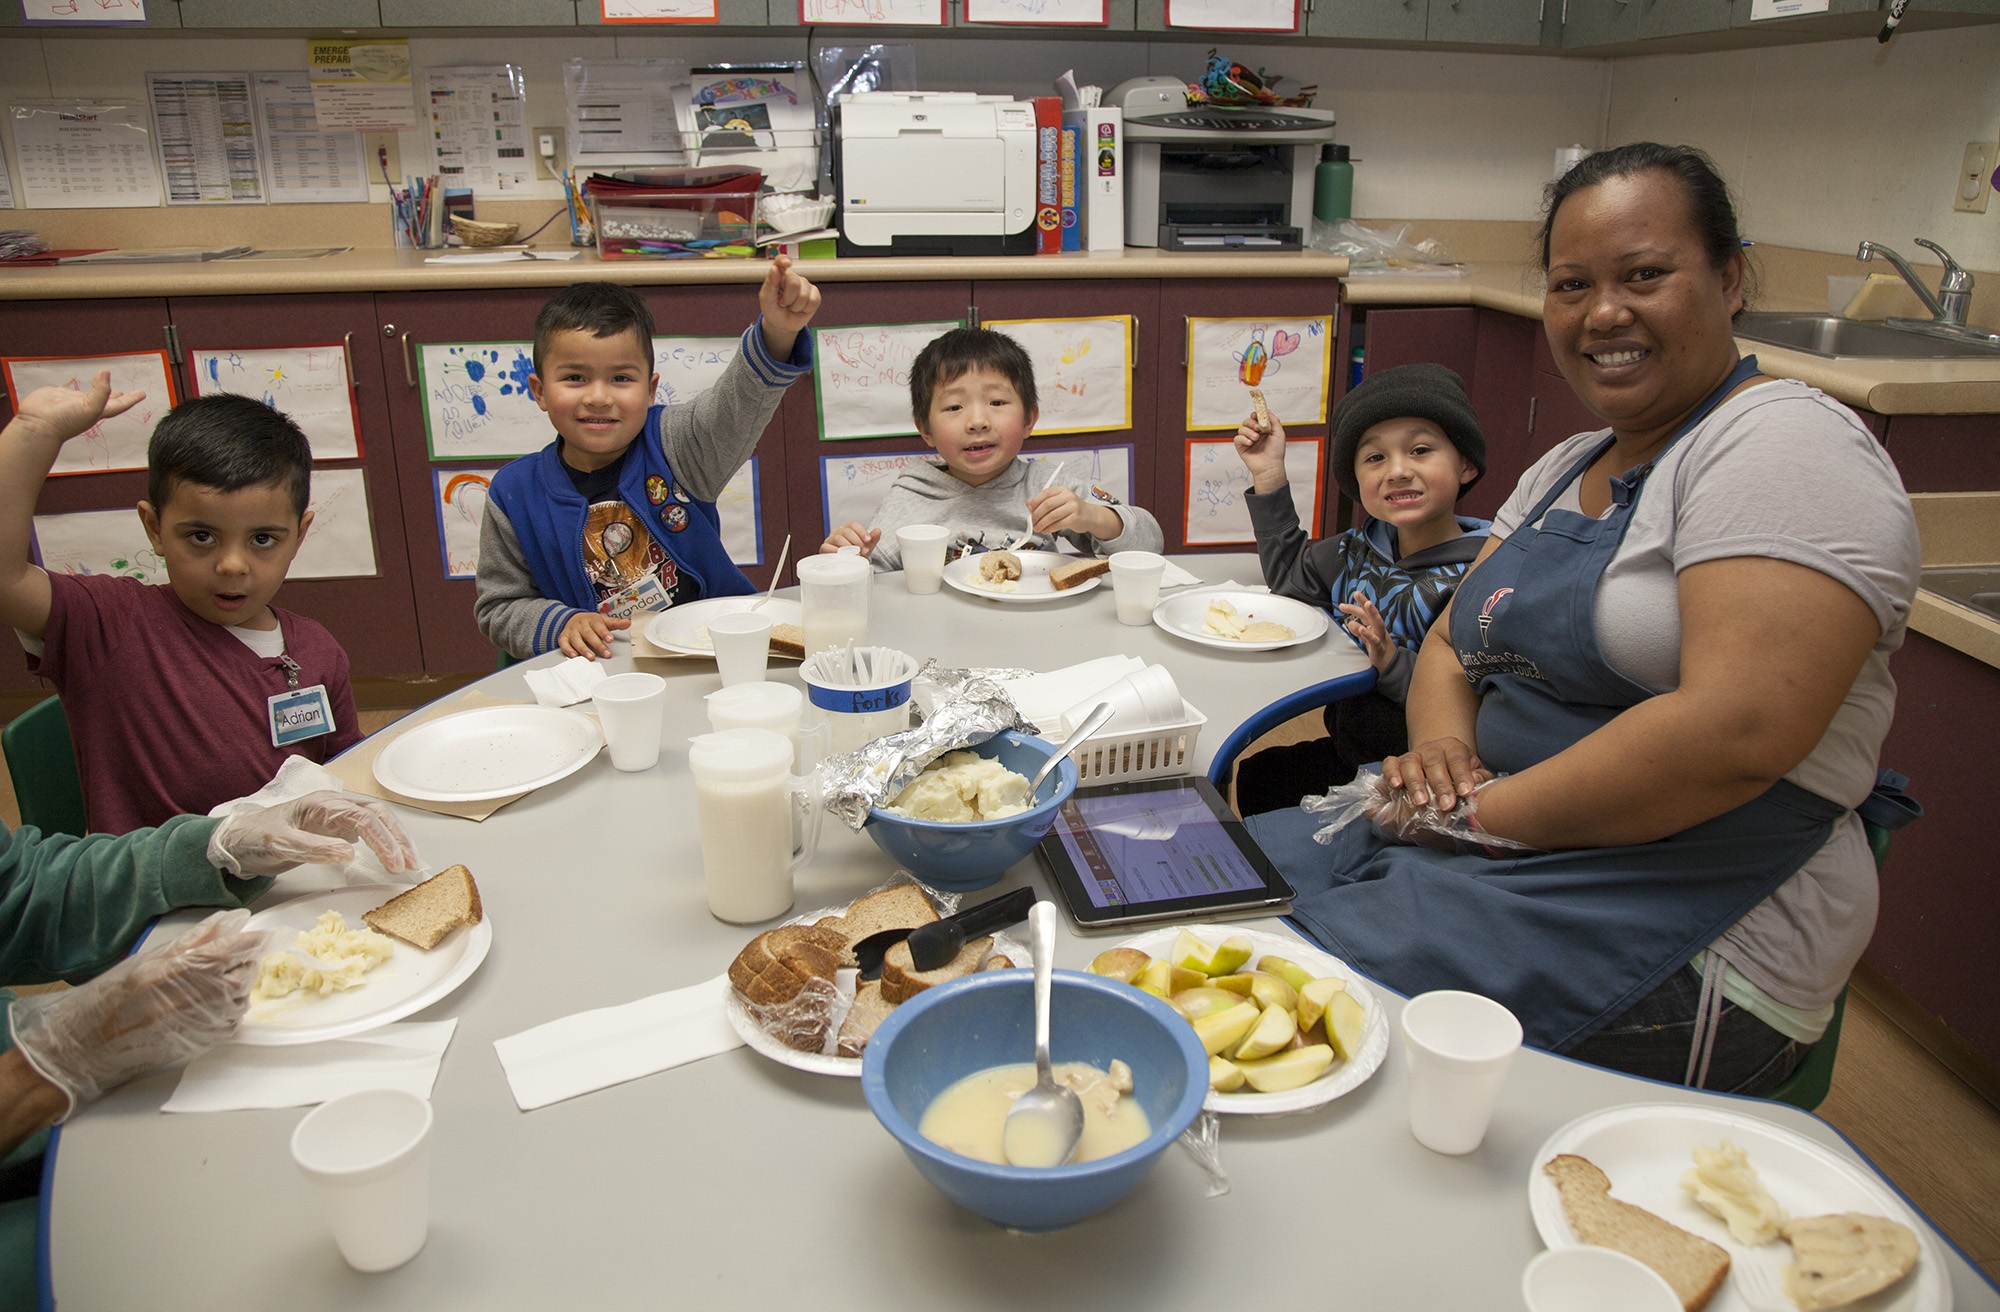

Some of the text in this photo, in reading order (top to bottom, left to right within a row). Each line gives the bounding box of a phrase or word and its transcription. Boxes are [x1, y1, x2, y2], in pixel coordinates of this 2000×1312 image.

[314, 46, 352, 54] EMERGE
[700, 77, 756, 102] Garden
[1040, 126, 1058, 205] ALPHA-BOTS
[852, 689, 900, 713] forks
[282, 710, 320, 727] Adrian
